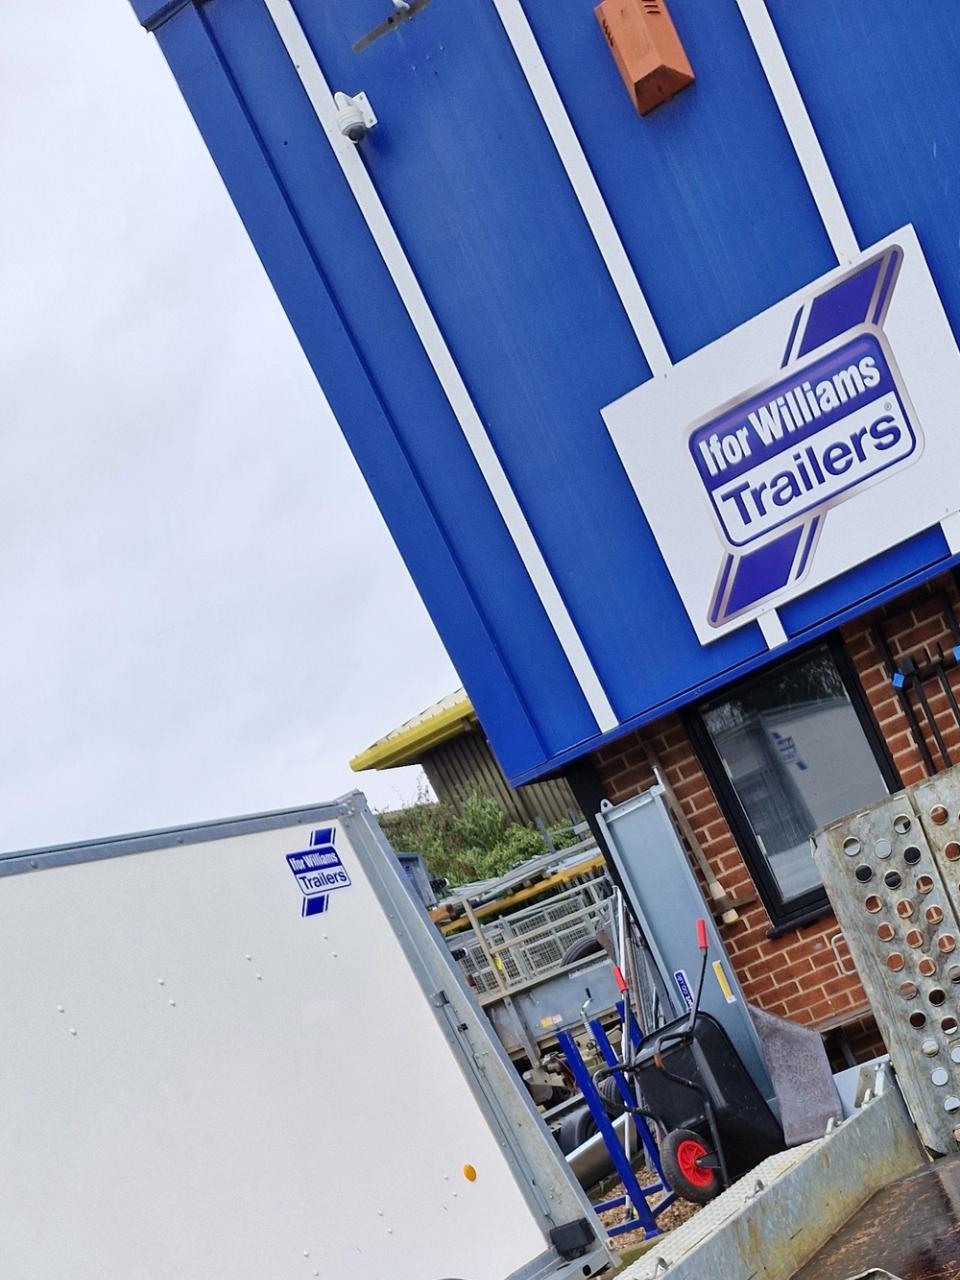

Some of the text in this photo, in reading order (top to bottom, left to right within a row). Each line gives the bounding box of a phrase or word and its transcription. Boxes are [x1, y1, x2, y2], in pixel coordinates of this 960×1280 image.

[698, 356, 880, 478] Ifor Williams
[721, 414, 901, 526] Trailers
[299, 871, 347, 890] Trailers
[302, 852, 339, 868] Williams
